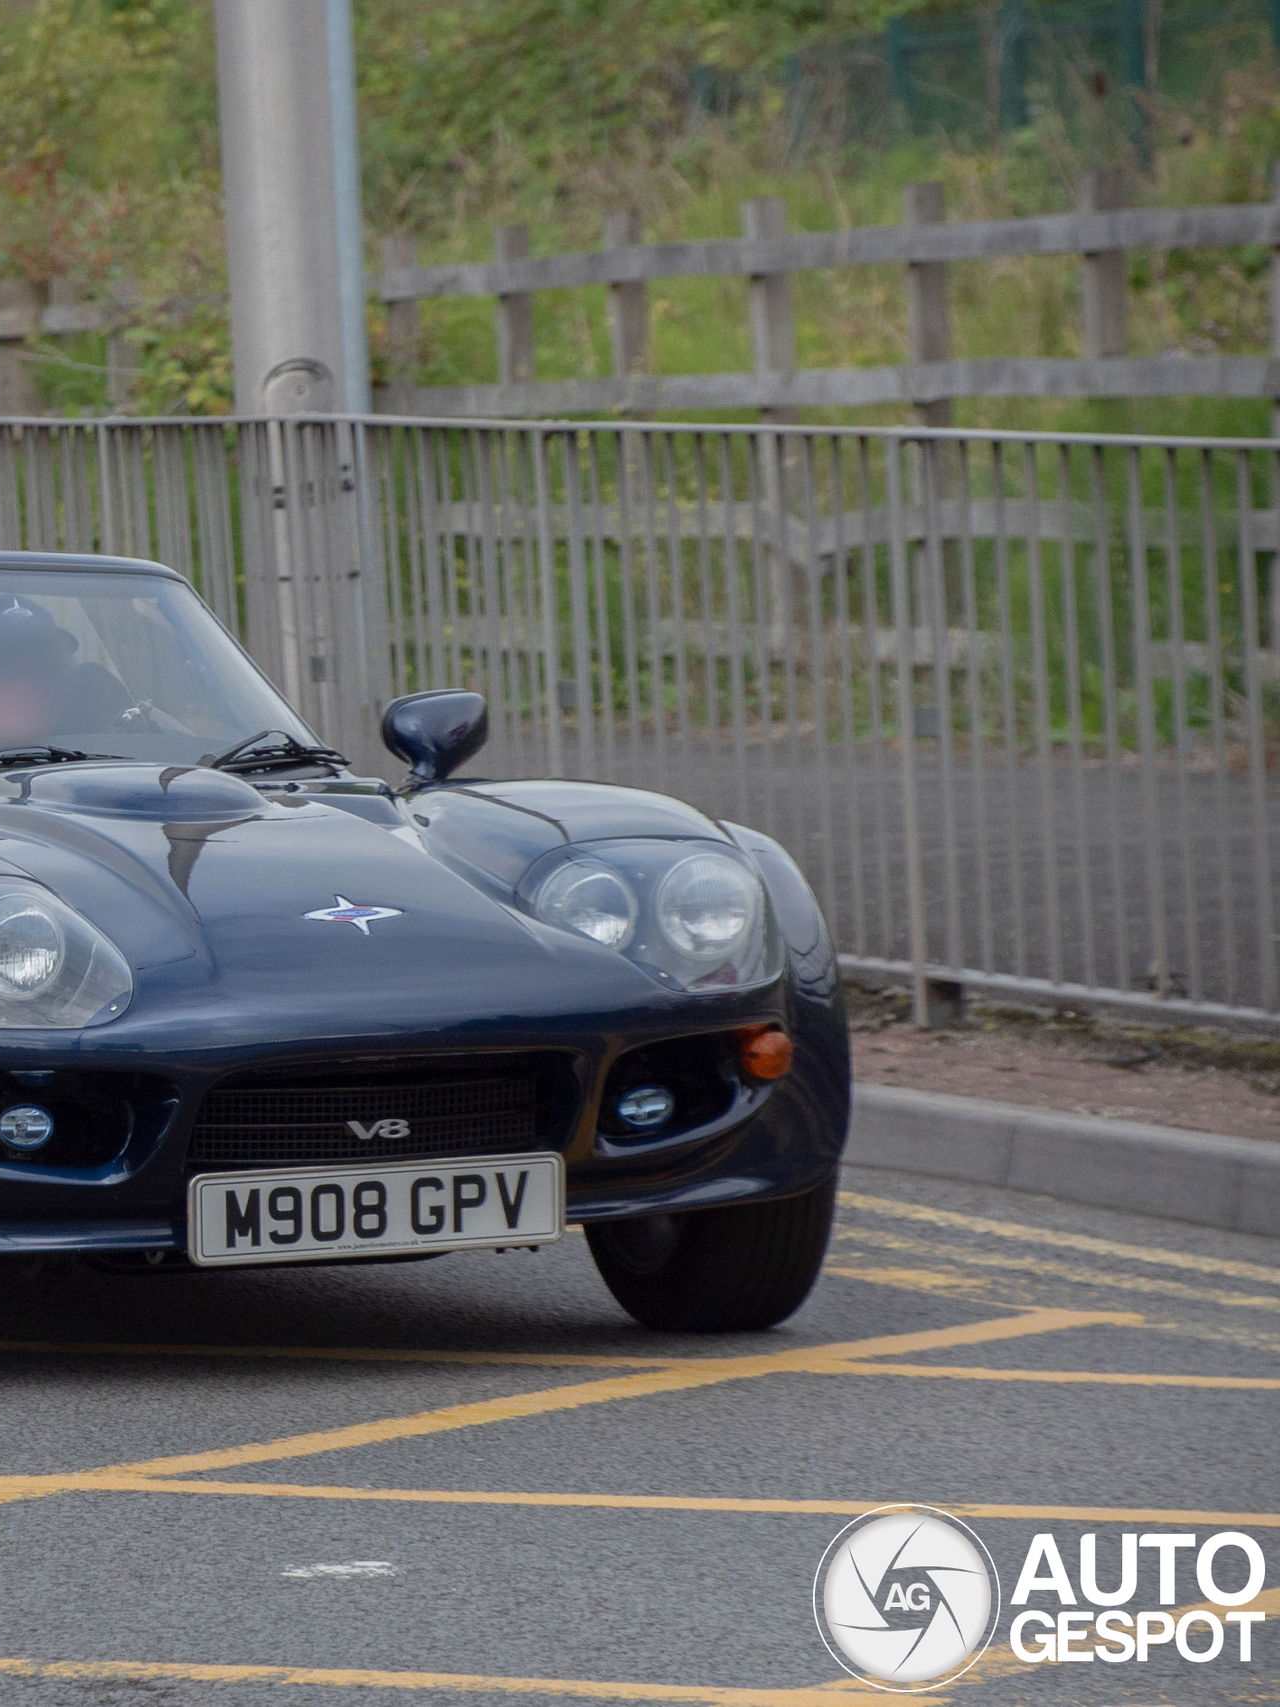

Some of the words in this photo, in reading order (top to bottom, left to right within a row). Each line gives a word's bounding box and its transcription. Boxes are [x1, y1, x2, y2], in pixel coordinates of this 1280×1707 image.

[346, 1119, 411, 1139] V8
[225, 1181, 388, 1248] M908
[410, 1171, 530, 1235] GPV
